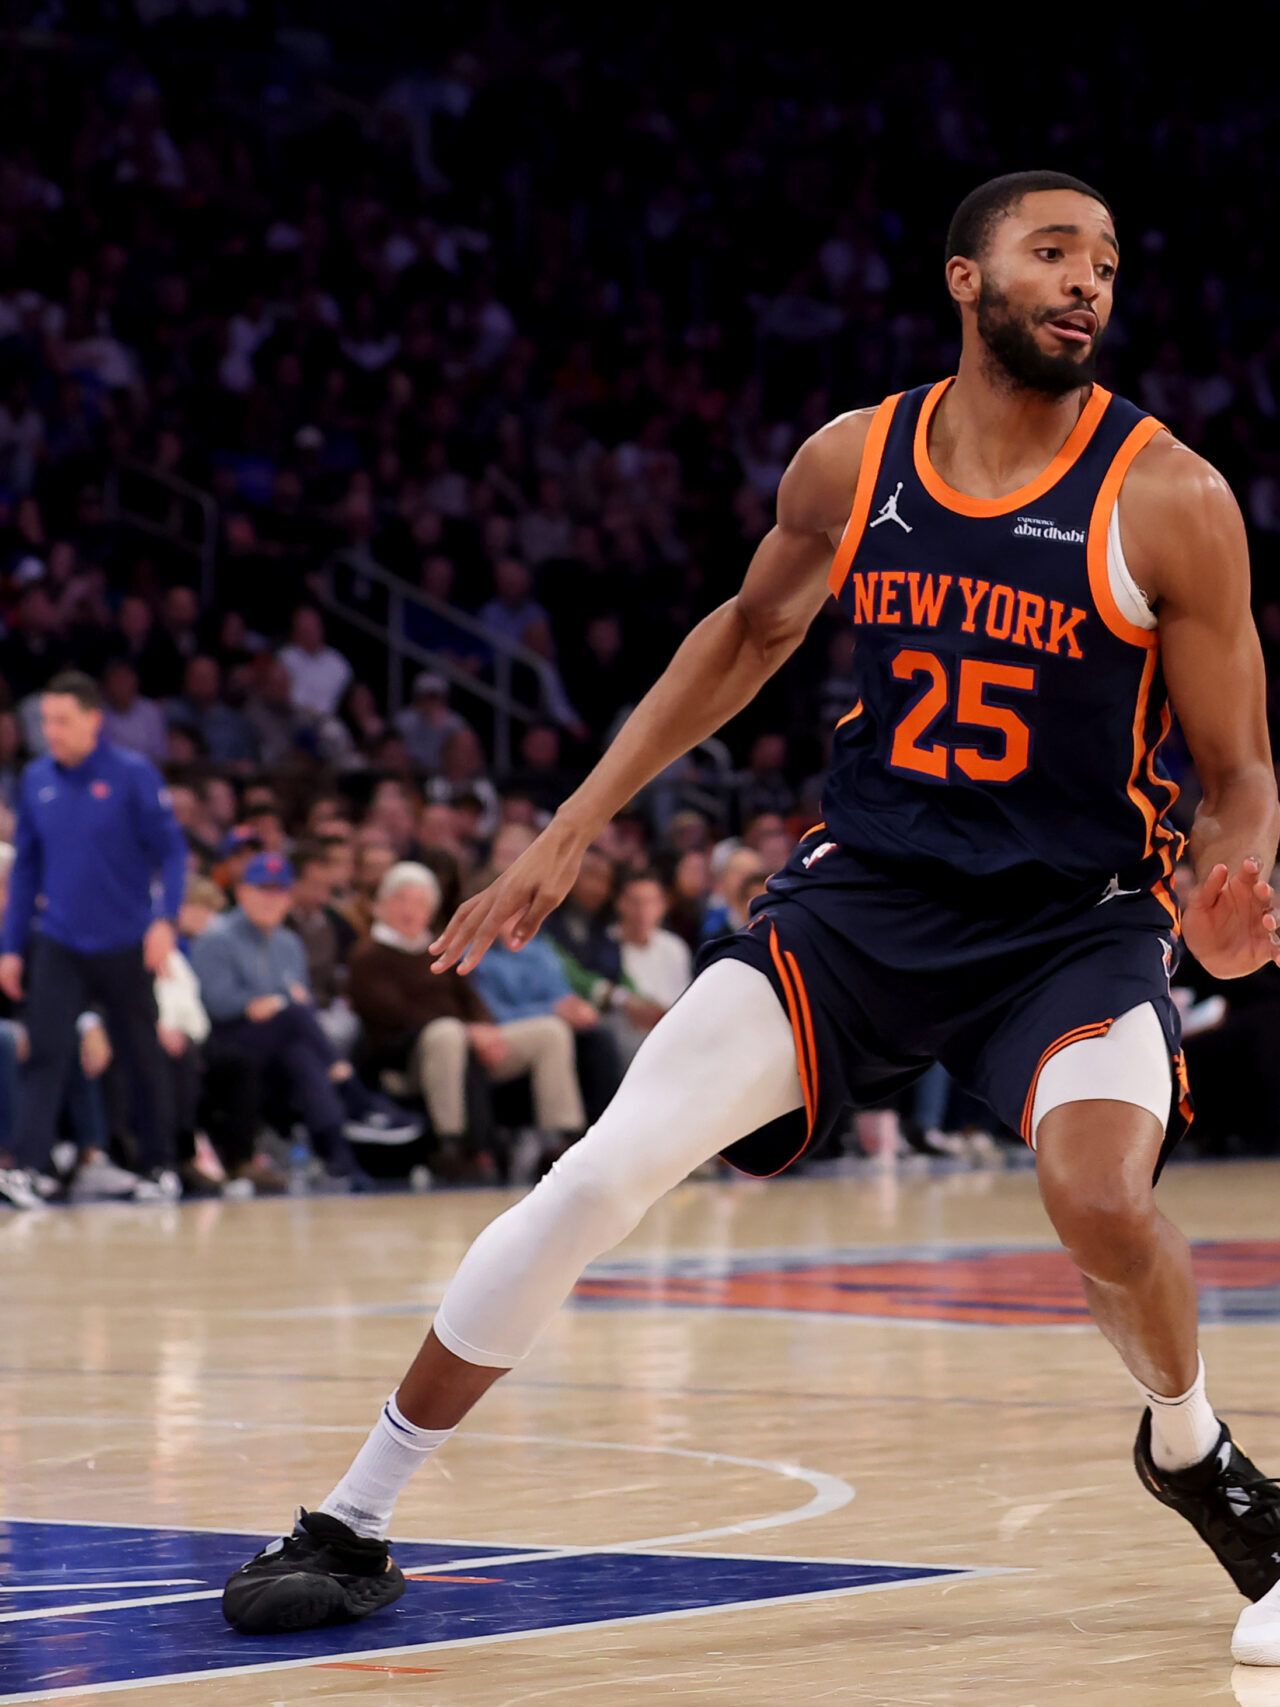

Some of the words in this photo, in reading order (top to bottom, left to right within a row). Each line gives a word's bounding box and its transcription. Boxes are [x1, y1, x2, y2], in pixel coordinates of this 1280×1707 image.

[1014, 523, 1042, 537] abu
[1043, 526, 1086, 543] dhabi
[853, 571, 952, 627] NEW
[958, 576, 1087, 659] YORK
[890, 648, 1036, 782] 25
